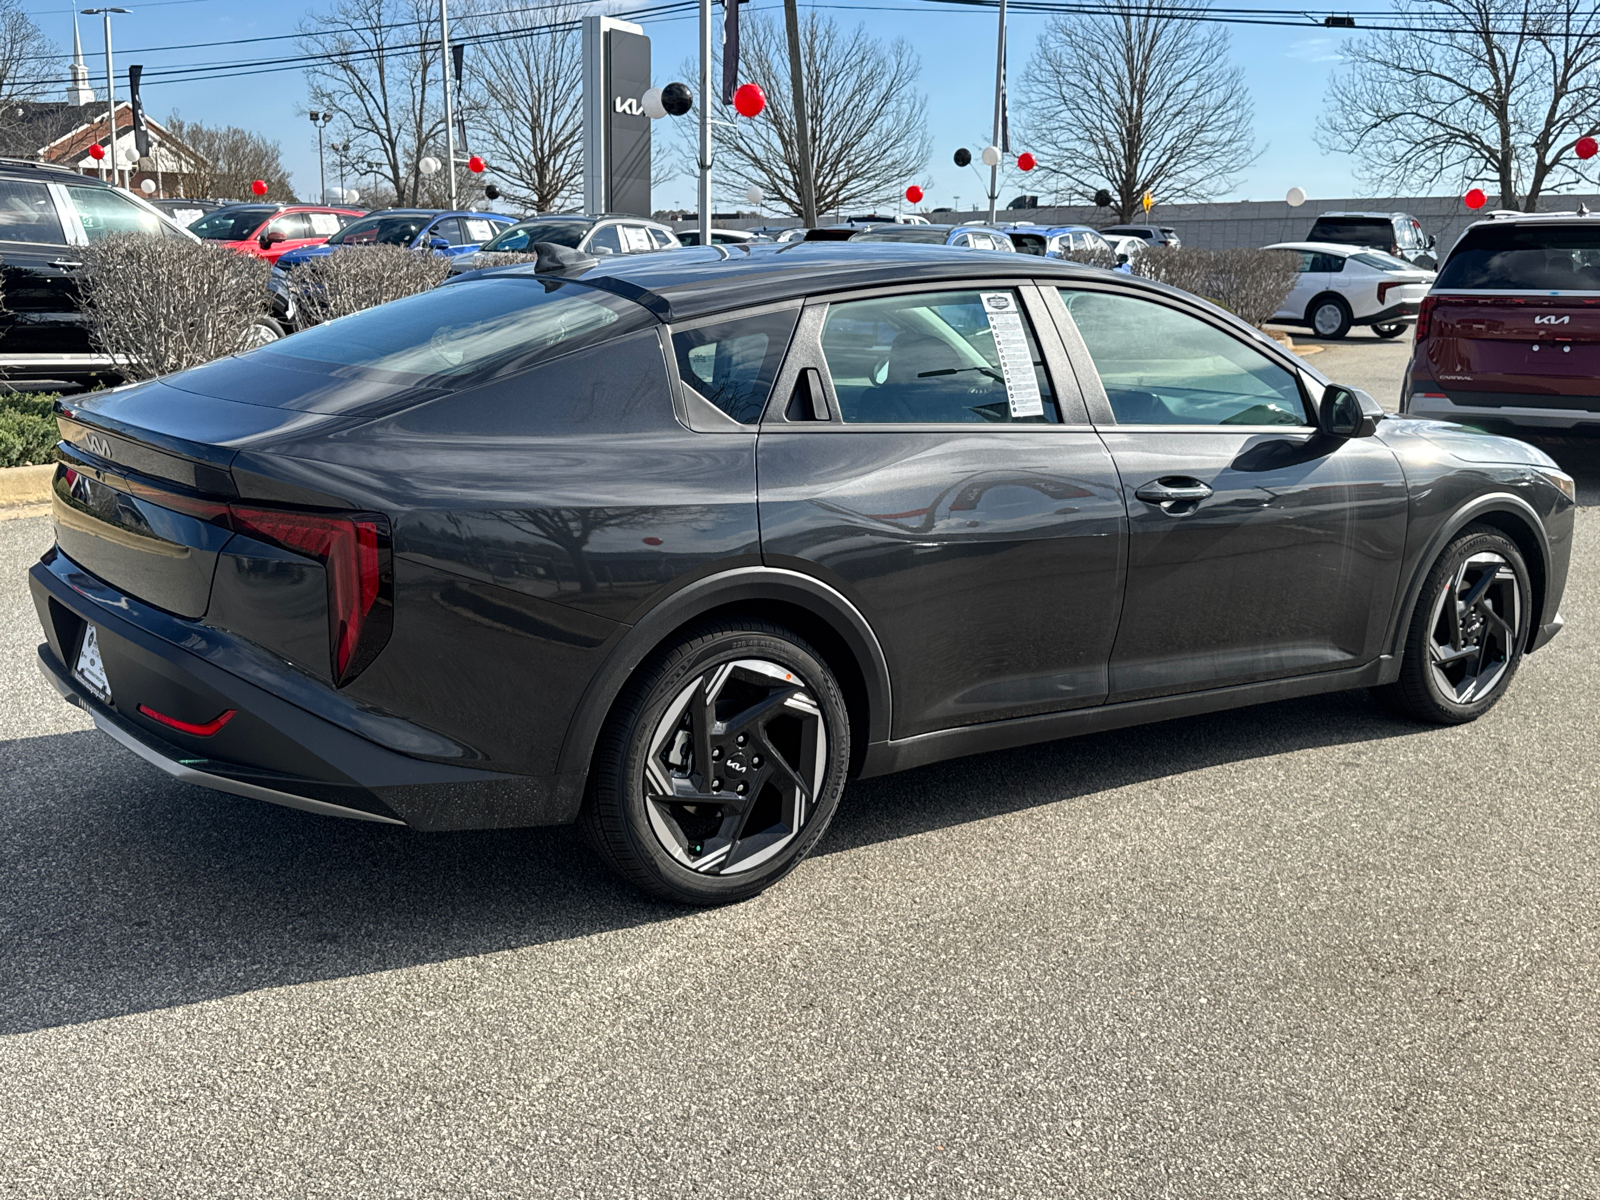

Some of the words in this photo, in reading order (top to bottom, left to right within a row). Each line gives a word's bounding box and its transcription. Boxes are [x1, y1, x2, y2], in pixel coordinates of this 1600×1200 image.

[1534, 315, 1570, 325] KIA
[85, 432, 112, 458] KIA
[1458, 536, 1488, 558] KUMHO
[726, 759, 747, 774] KIA
[830, 735, 847, 800] KUMHO
